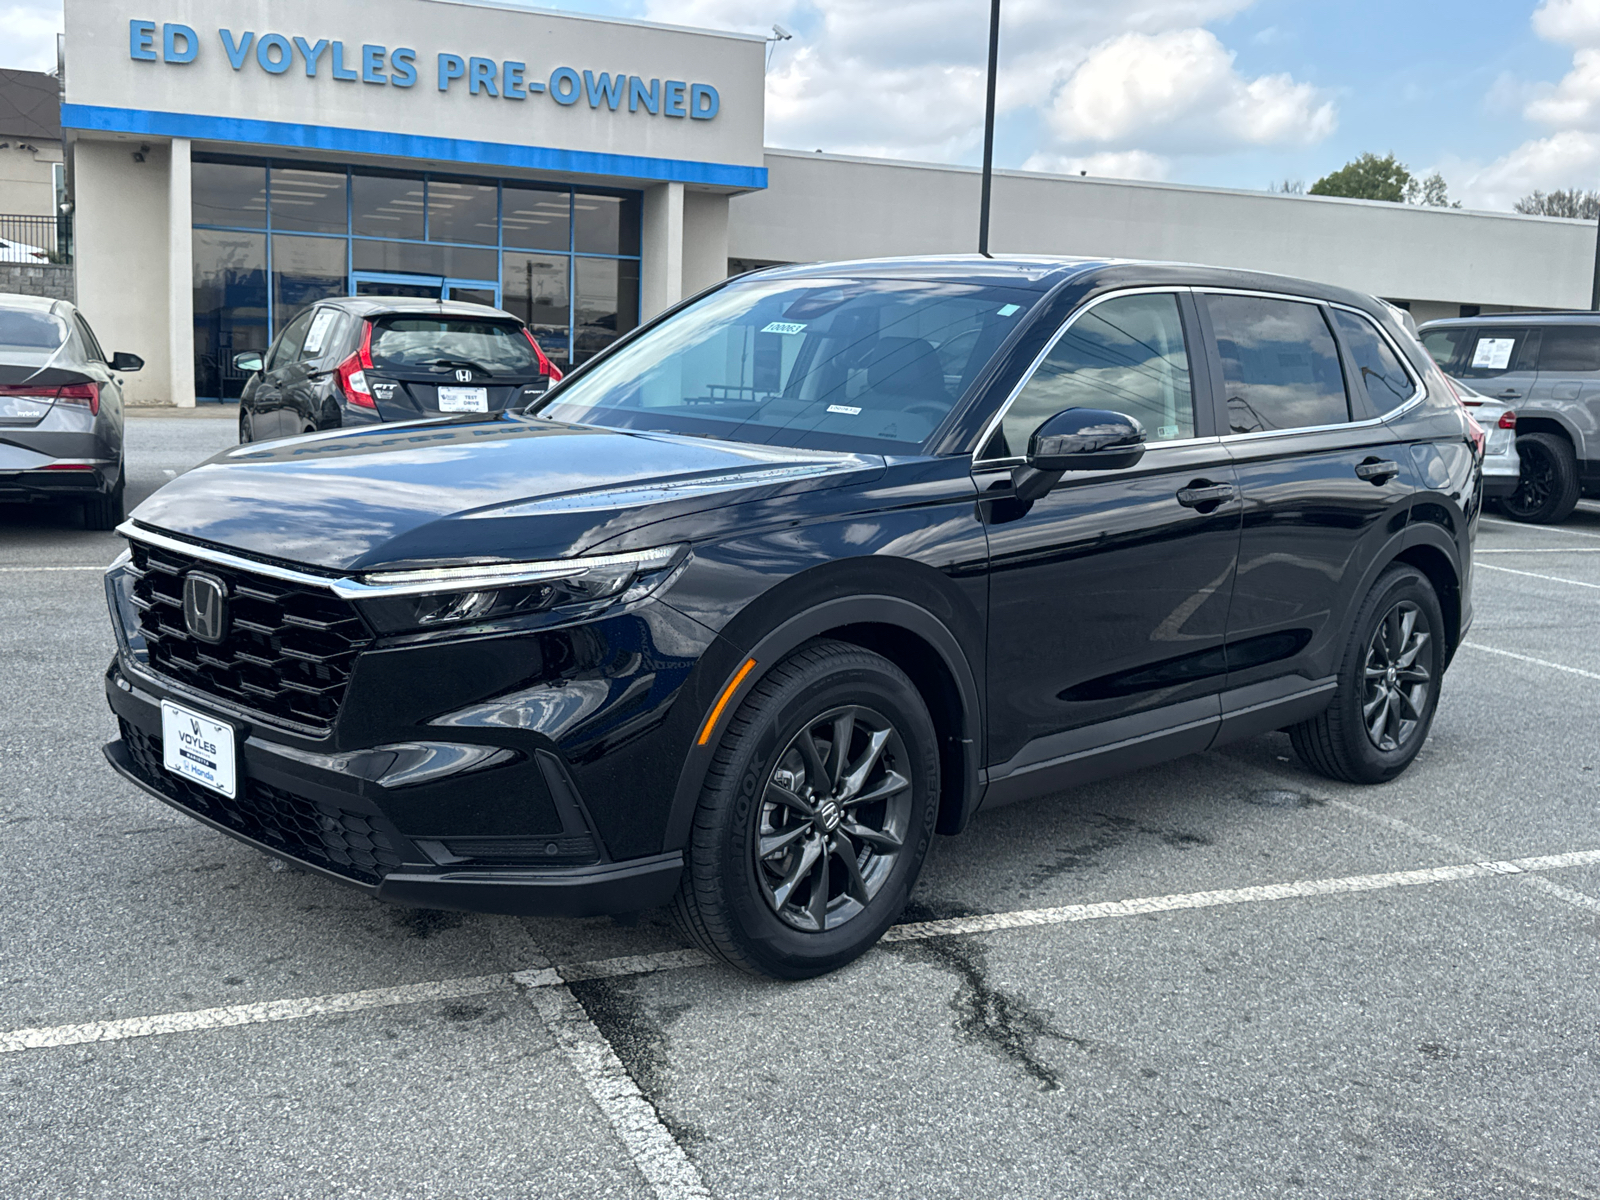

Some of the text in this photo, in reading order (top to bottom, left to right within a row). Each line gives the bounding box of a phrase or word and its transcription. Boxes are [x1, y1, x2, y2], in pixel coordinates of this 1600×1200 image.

[129, 19, 720, 120] ED VOYLES PRE-OWNED
[178, 729, 217, 755] VOYLES
[191, 764, 215, 781] Honda
